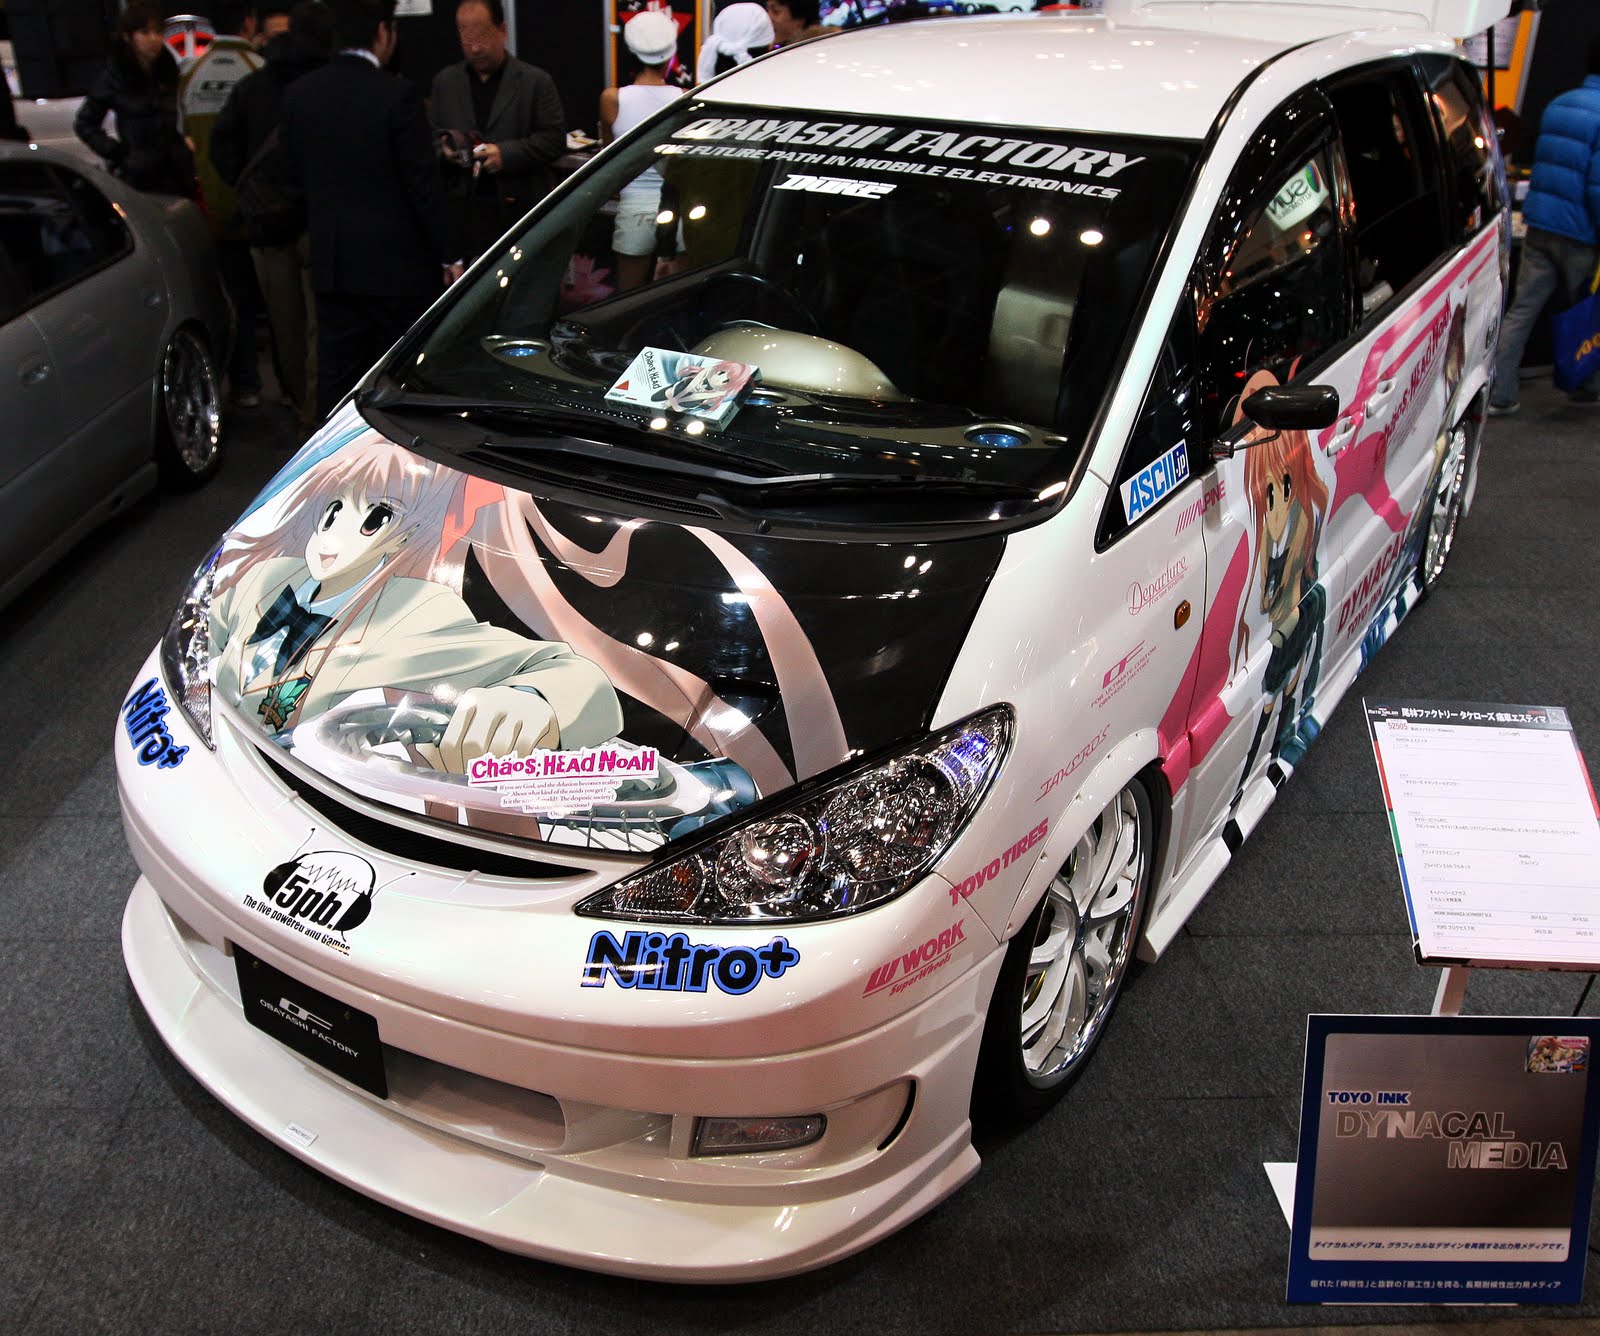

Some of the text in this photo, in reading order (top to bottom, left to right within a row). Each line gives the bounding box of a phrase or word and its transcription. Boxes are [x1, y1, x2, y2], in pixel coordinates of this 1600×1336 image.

[671, 117, 1146, 177] OBAYASHI FACTORY
[691, 145, 767, 161] FUTURE
[767, 150, 823, 166] PATH
[821, 155, 853, 167] IN
[851, 157, 946, 178] MOBILE
[945, 167, 1121, 200] ELECTRONICS
[1126, 556, 1189, 616] Departure
[949, 817, 1050, 907] TOYO TIRES
[243, 894, 258, 910] The
[256, 901, 272, 916] five
[305, 926, 322, 942] and
[275, 874, 343, 930] 5pb.
[580, 930, 801, 996] Nitro+
[898, 918, 967, 974] WORK
[259, 999, 359, 1058] OBAYASHI FACTORY
[1327, 1090, 1411, 1106] TOYO INK
[1335, 1110, 1516, 1140] DYNACAL
[1447, 1141, 1568, 1170] MEDIA
